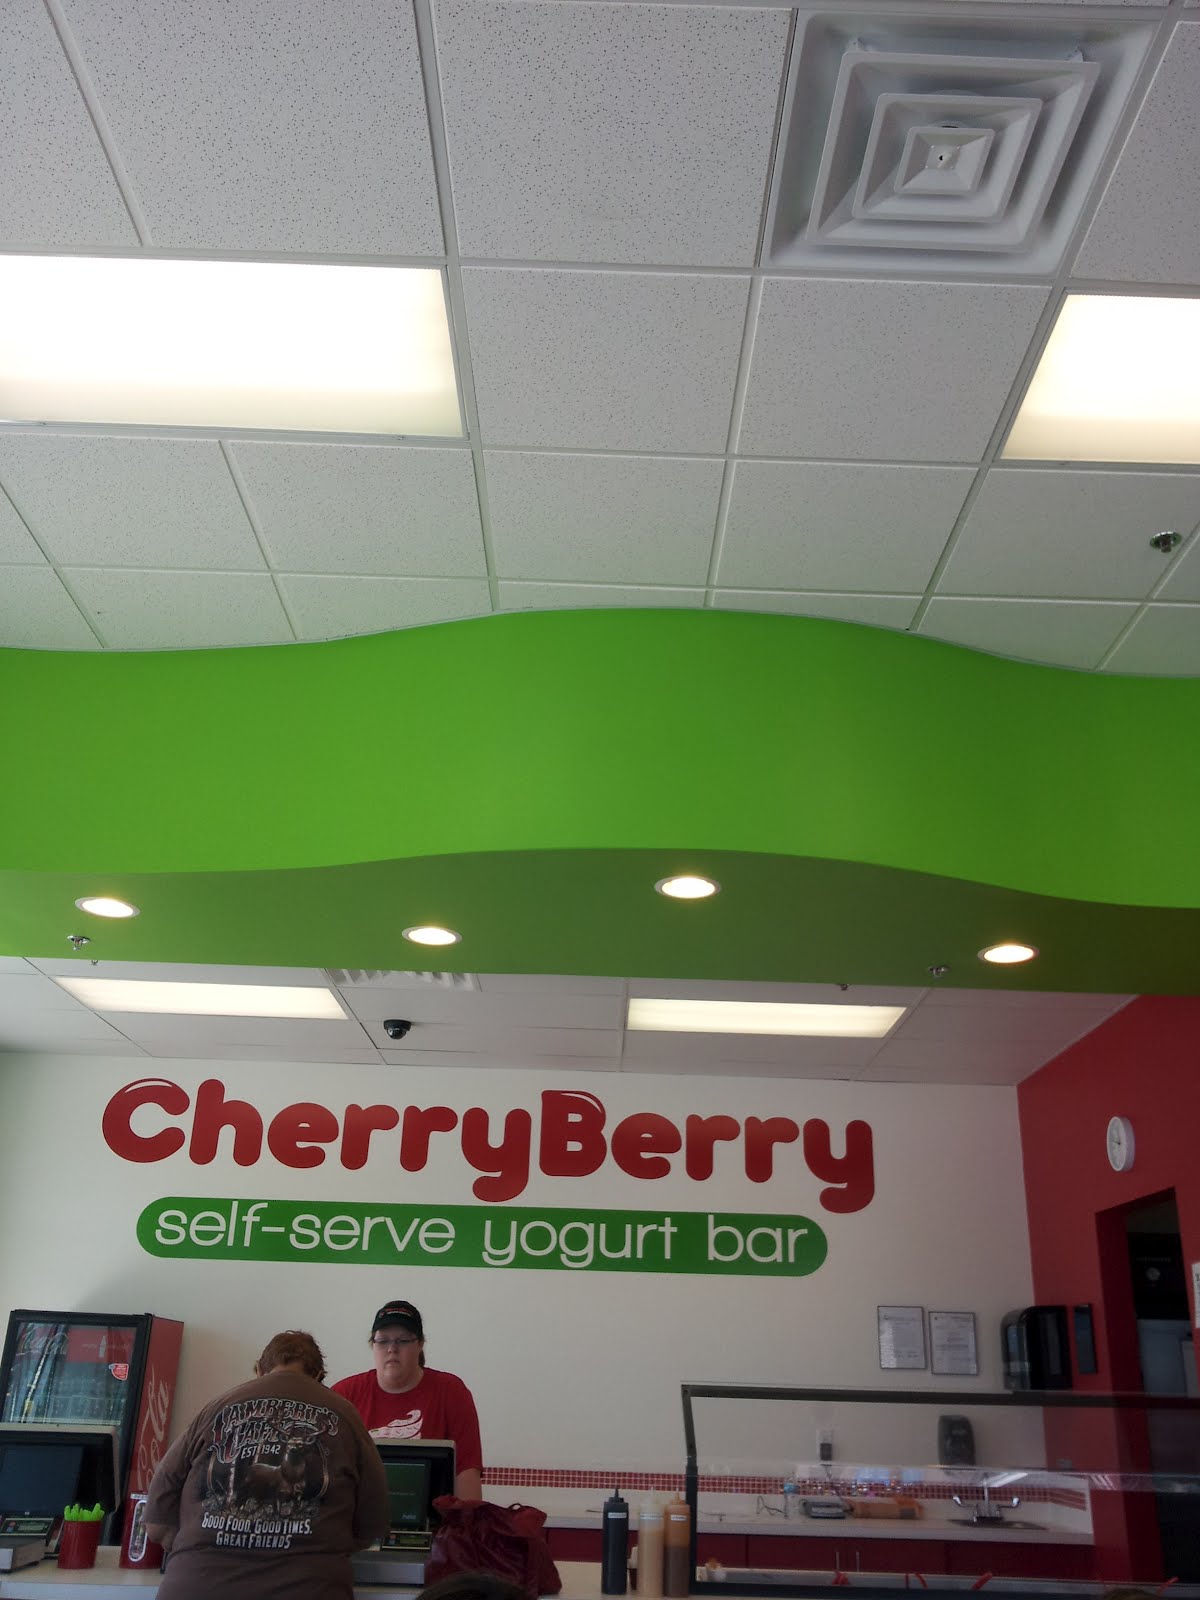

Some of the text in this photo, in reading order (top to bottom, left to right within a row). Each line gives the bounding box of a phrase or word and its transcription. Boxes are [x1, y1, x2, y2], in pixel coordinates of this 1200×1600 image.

[101, 1078, 875, 1213] CherryBerry
[155, 1201, 809, 1266] self-serve yogurt bar
[261, 1444, 281, 1455] 1942
[201, 1512, 225, 1530] GOOD
[254, 1518, 281, 1534] GOOD
[216, 1531, 292, 1549] GREAT FRIENDS
